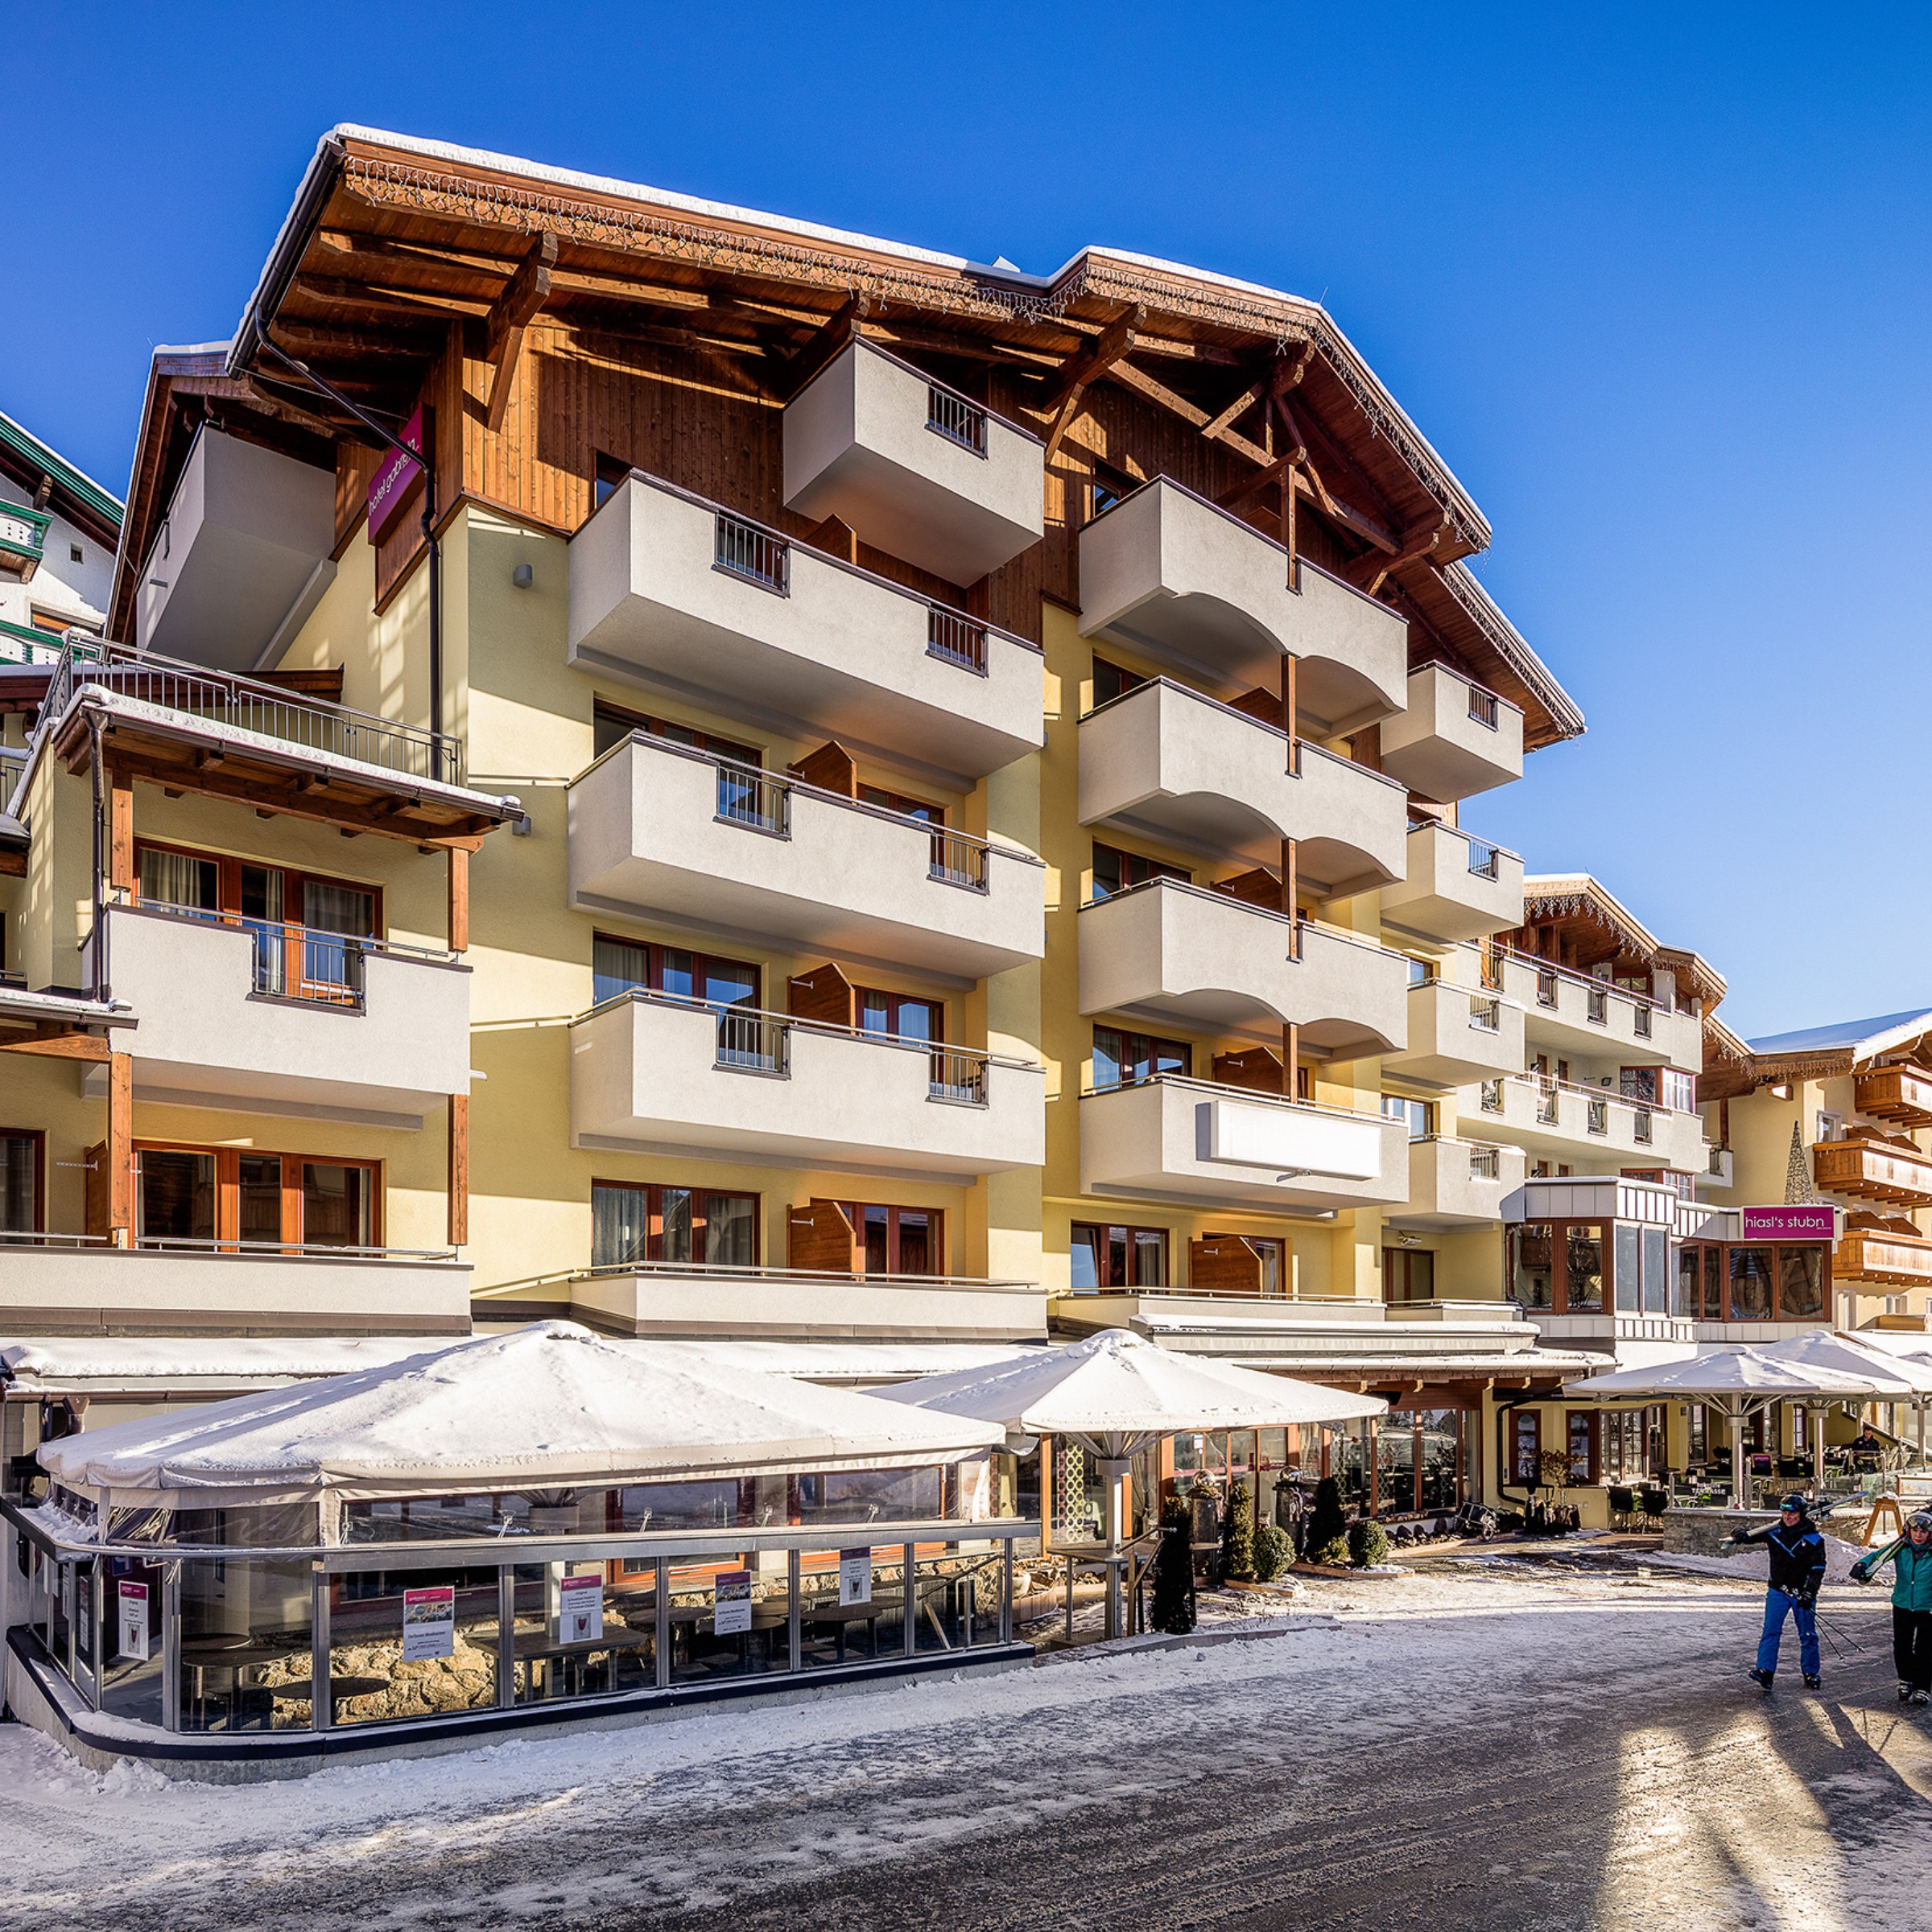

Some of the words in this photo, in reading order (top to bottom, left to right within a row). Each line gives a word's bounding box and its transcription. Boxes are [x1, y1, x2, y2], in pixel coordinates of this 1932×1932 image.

[369, 478, 386, 516] hotel
[1745, 1216, 1784, 1228] hiasl's
[1787, 1215, 1825, 1228] stubn
